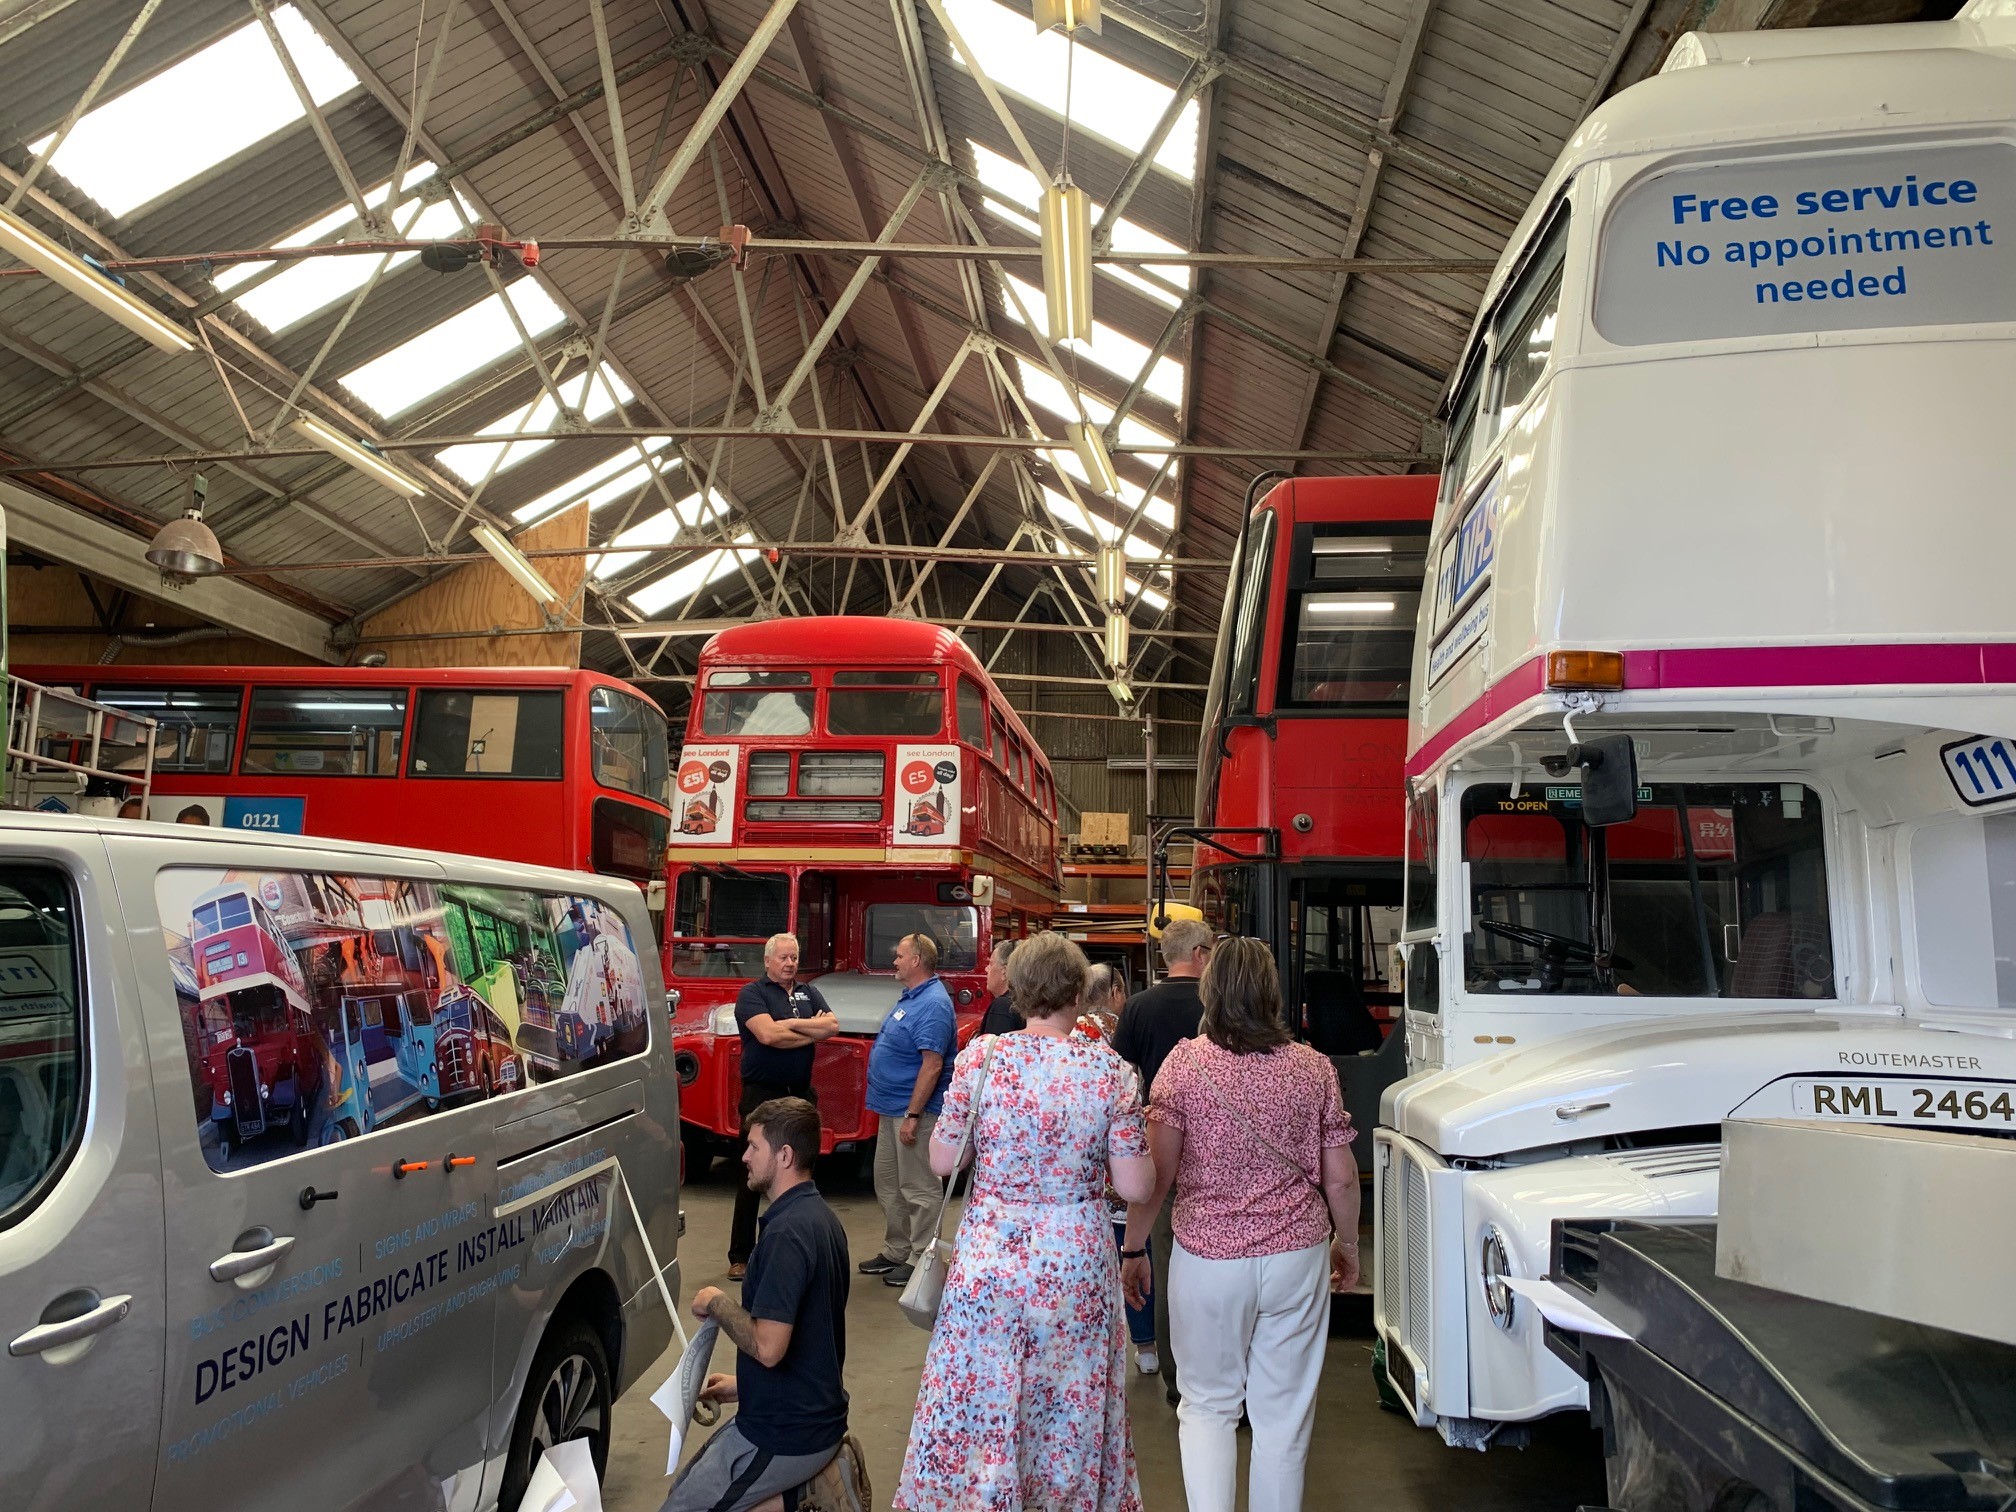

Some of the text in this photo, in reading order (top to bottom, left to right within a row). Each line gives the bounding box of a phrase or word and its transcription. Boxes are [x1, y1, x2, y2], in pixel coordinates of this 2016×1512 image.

[1672, 174, 1978, 225] Free service
[1656, 219, 1994, 268] No appointment
[1756, 265, 1907, 304] needed
[1456, 496, 1498, 595] NHS
[1454, 614, 1479, 651] wellbeing
[698, 749, 730, 757] London!
[922, 749, 955, 757] London!
[1954, 740, 2016, 794] 111
[242, 813, 280, 829] 0121
[1498, 801, 1548, 811] TO OPEN
[1838, 1051, 1982, 1070] ROUTEMASTER
[1813, 1084, 2015, 1122] RML 2464
[375, 1201, 478, 1260] SIGNS AND WRAPS
[189, 1256, 345, 1342] BUS CONVERSIONS
[195, 1179, 600, 1406] DESIGN FABRICATE INSTALL MAINTAIN
[377, 1263, 521, 1353] UPHOLSTERY AND ENGRAVING
[166, 1353, 350, 1468] PROMOTIONAL VEHICLES
